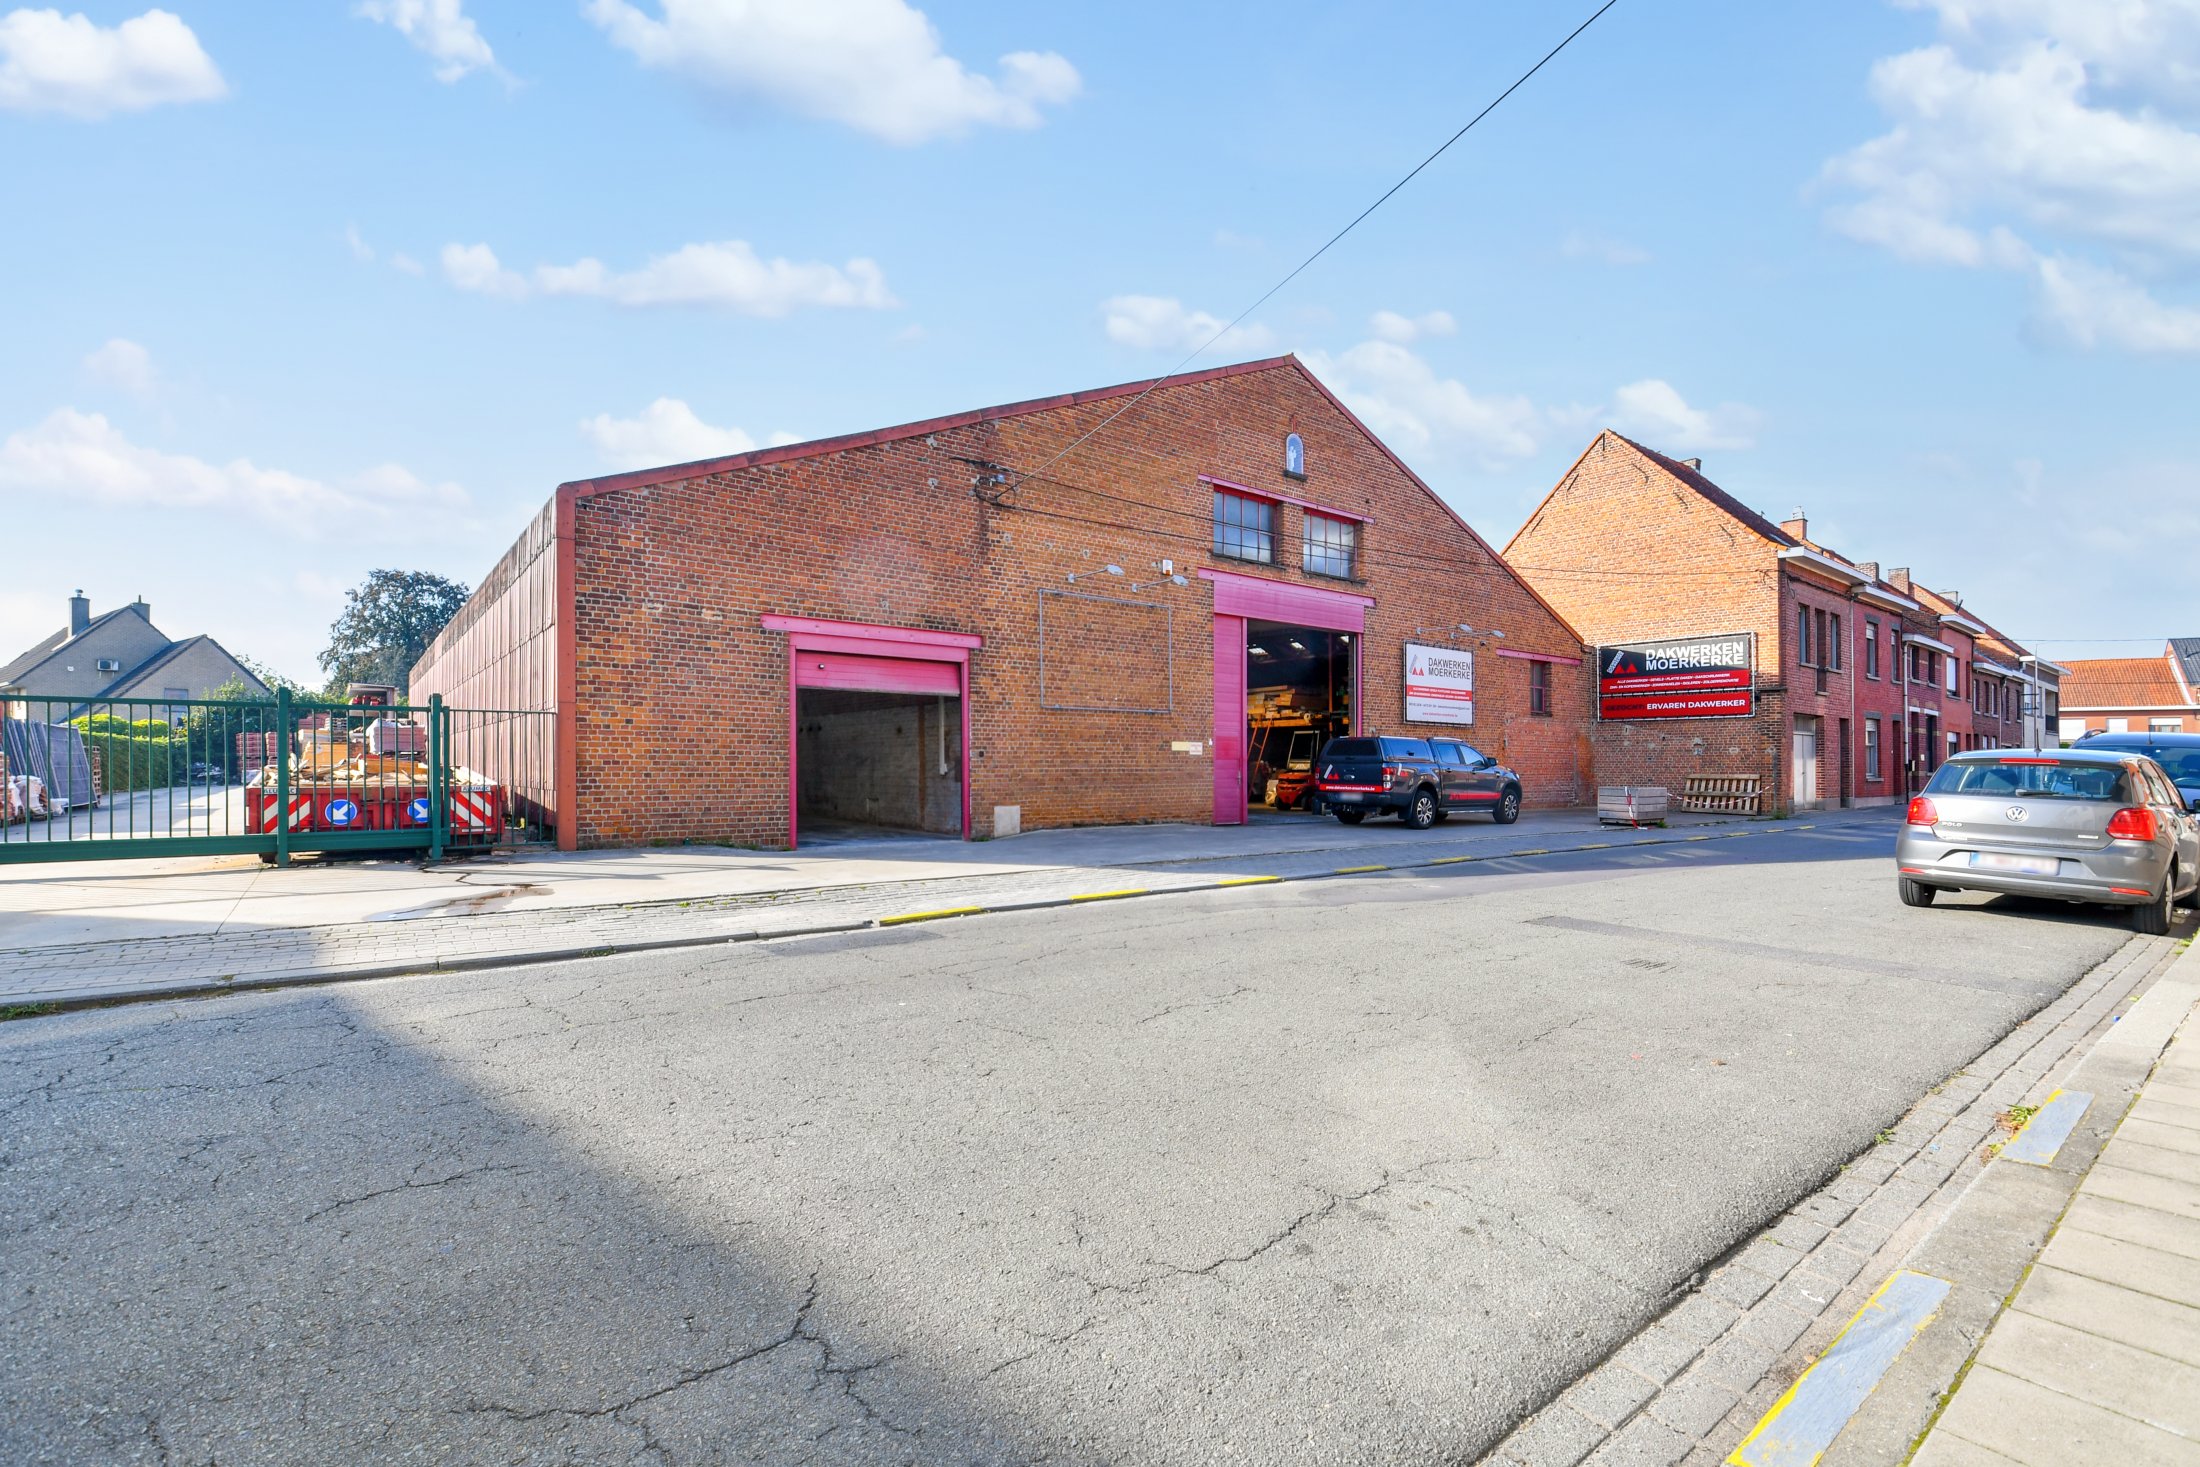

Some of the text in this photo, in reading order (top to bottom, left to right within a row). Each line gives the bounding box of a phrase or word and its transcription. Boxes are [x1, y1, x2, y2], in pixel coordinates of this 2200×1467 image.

[1645, 641, 1744, 660] DAKWERKEN
[1428, 657, 1471, 671] DAKWERKEN
[1645, 653, 1744, 671] MOERKERKE
[1428, 667, 1471, 680] MOERKERKE
[1646, 702, 1686, 710] ERVAREN
[1687, 699, 1746, 709] DAKWERKER
